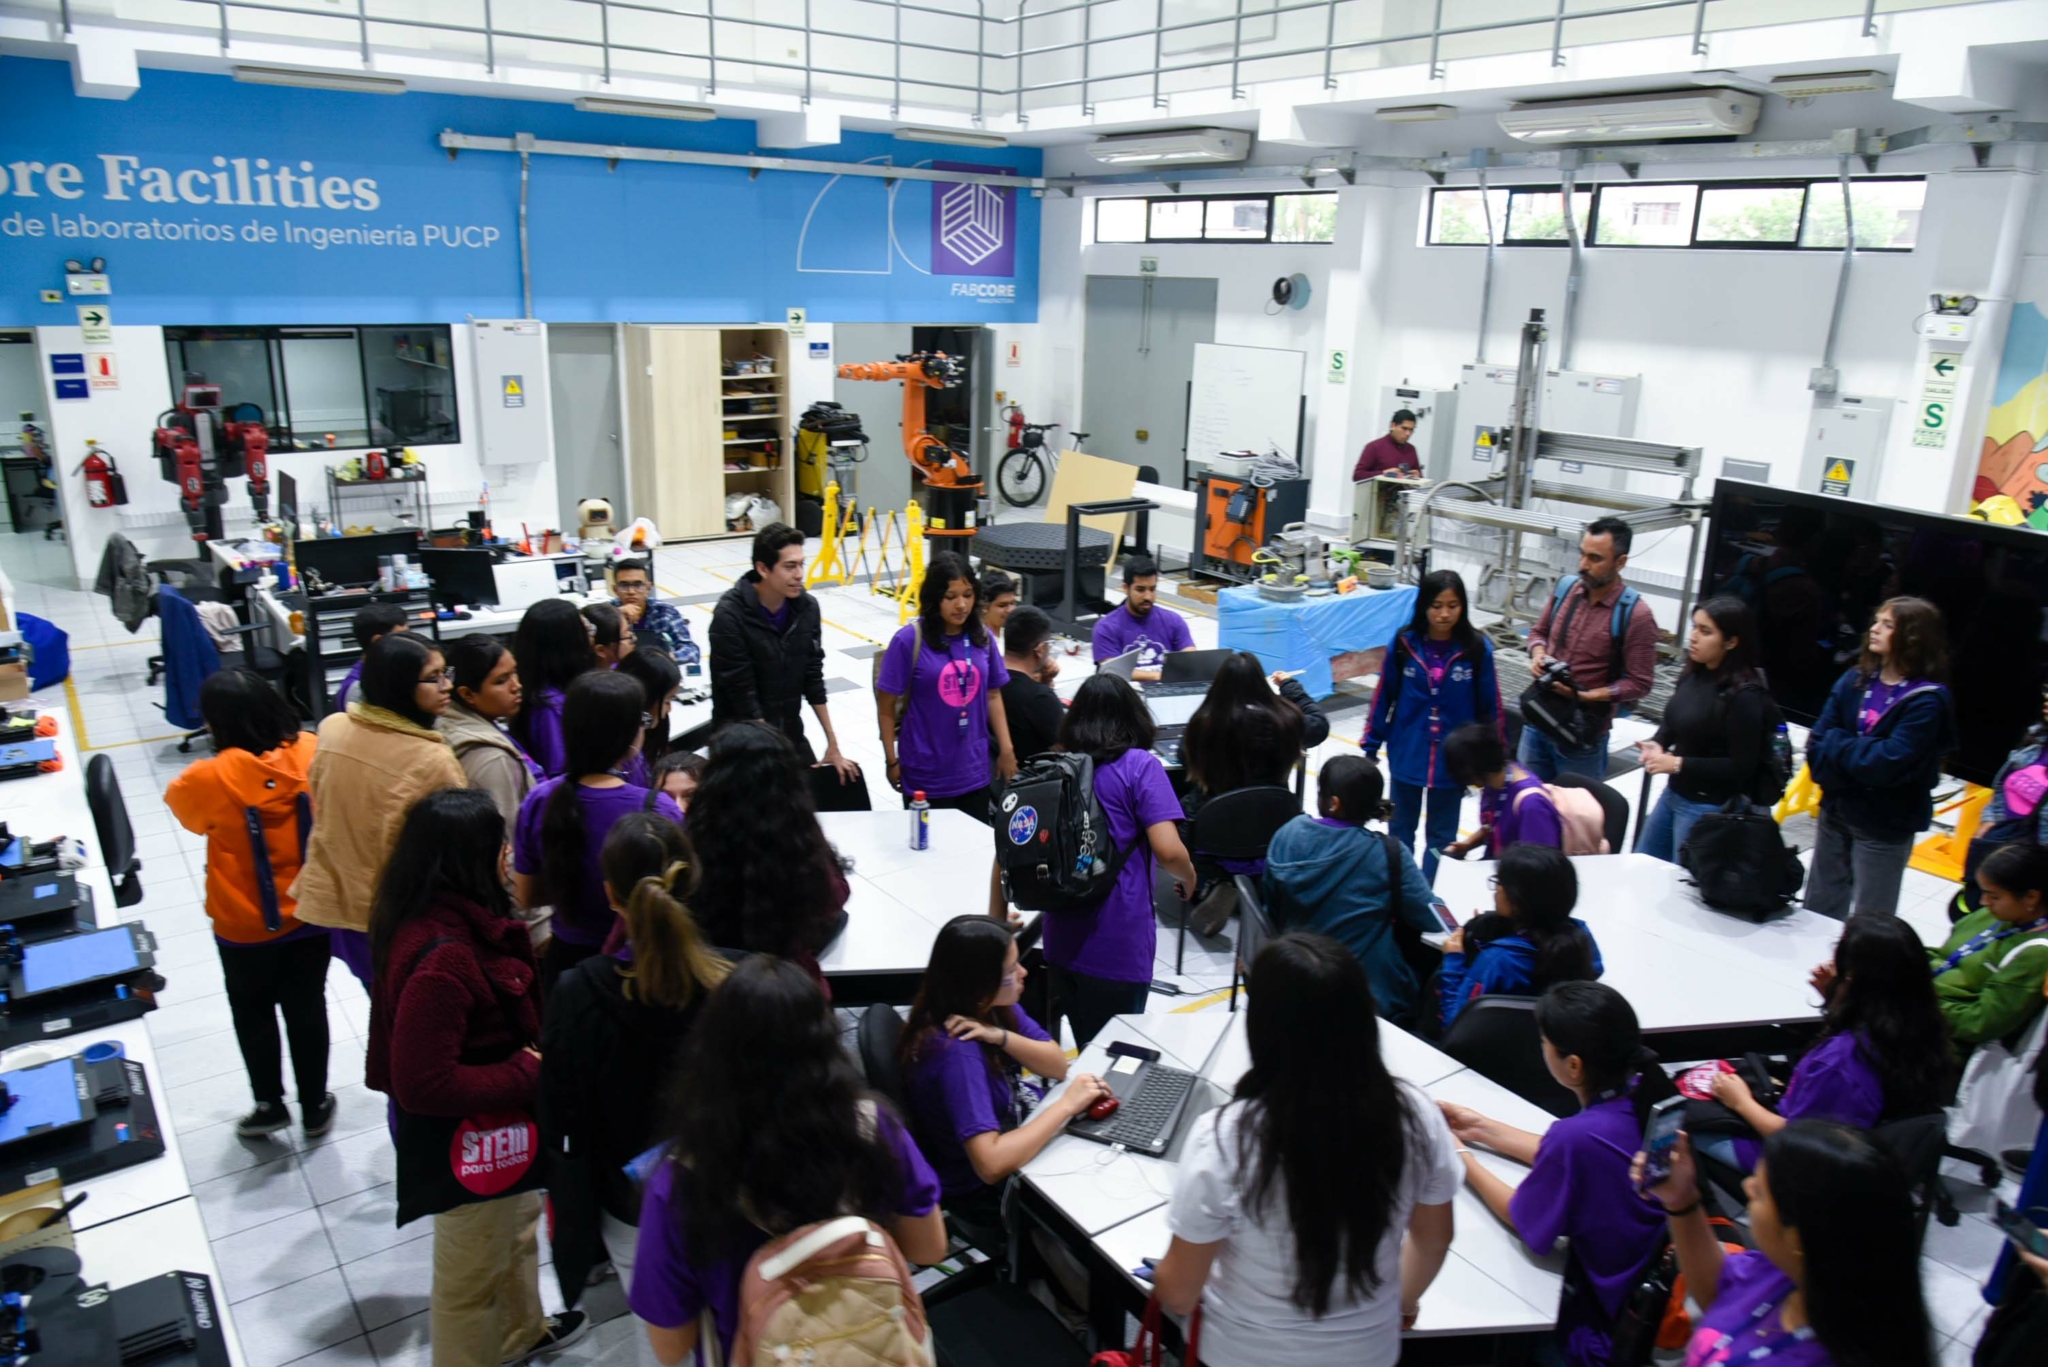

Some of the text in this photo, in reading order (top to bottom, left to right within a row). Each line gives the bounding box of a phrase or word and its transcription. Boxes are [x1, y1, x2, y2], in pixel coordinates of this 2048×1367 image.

[0, 153, 380, 212] re Facilities
[2, 211, 45, 237] de
[51, 212, 236, 242] laboratorios
[241, 219, 278, 243] de
[423, 224, 500, 248] PUCP
[950, 283, 1016, 297] FABCORE
[1332, 352, 1344, 370] S
[1924, 403, 1945, 428] S
[461, 1163, 493, 1177] para
